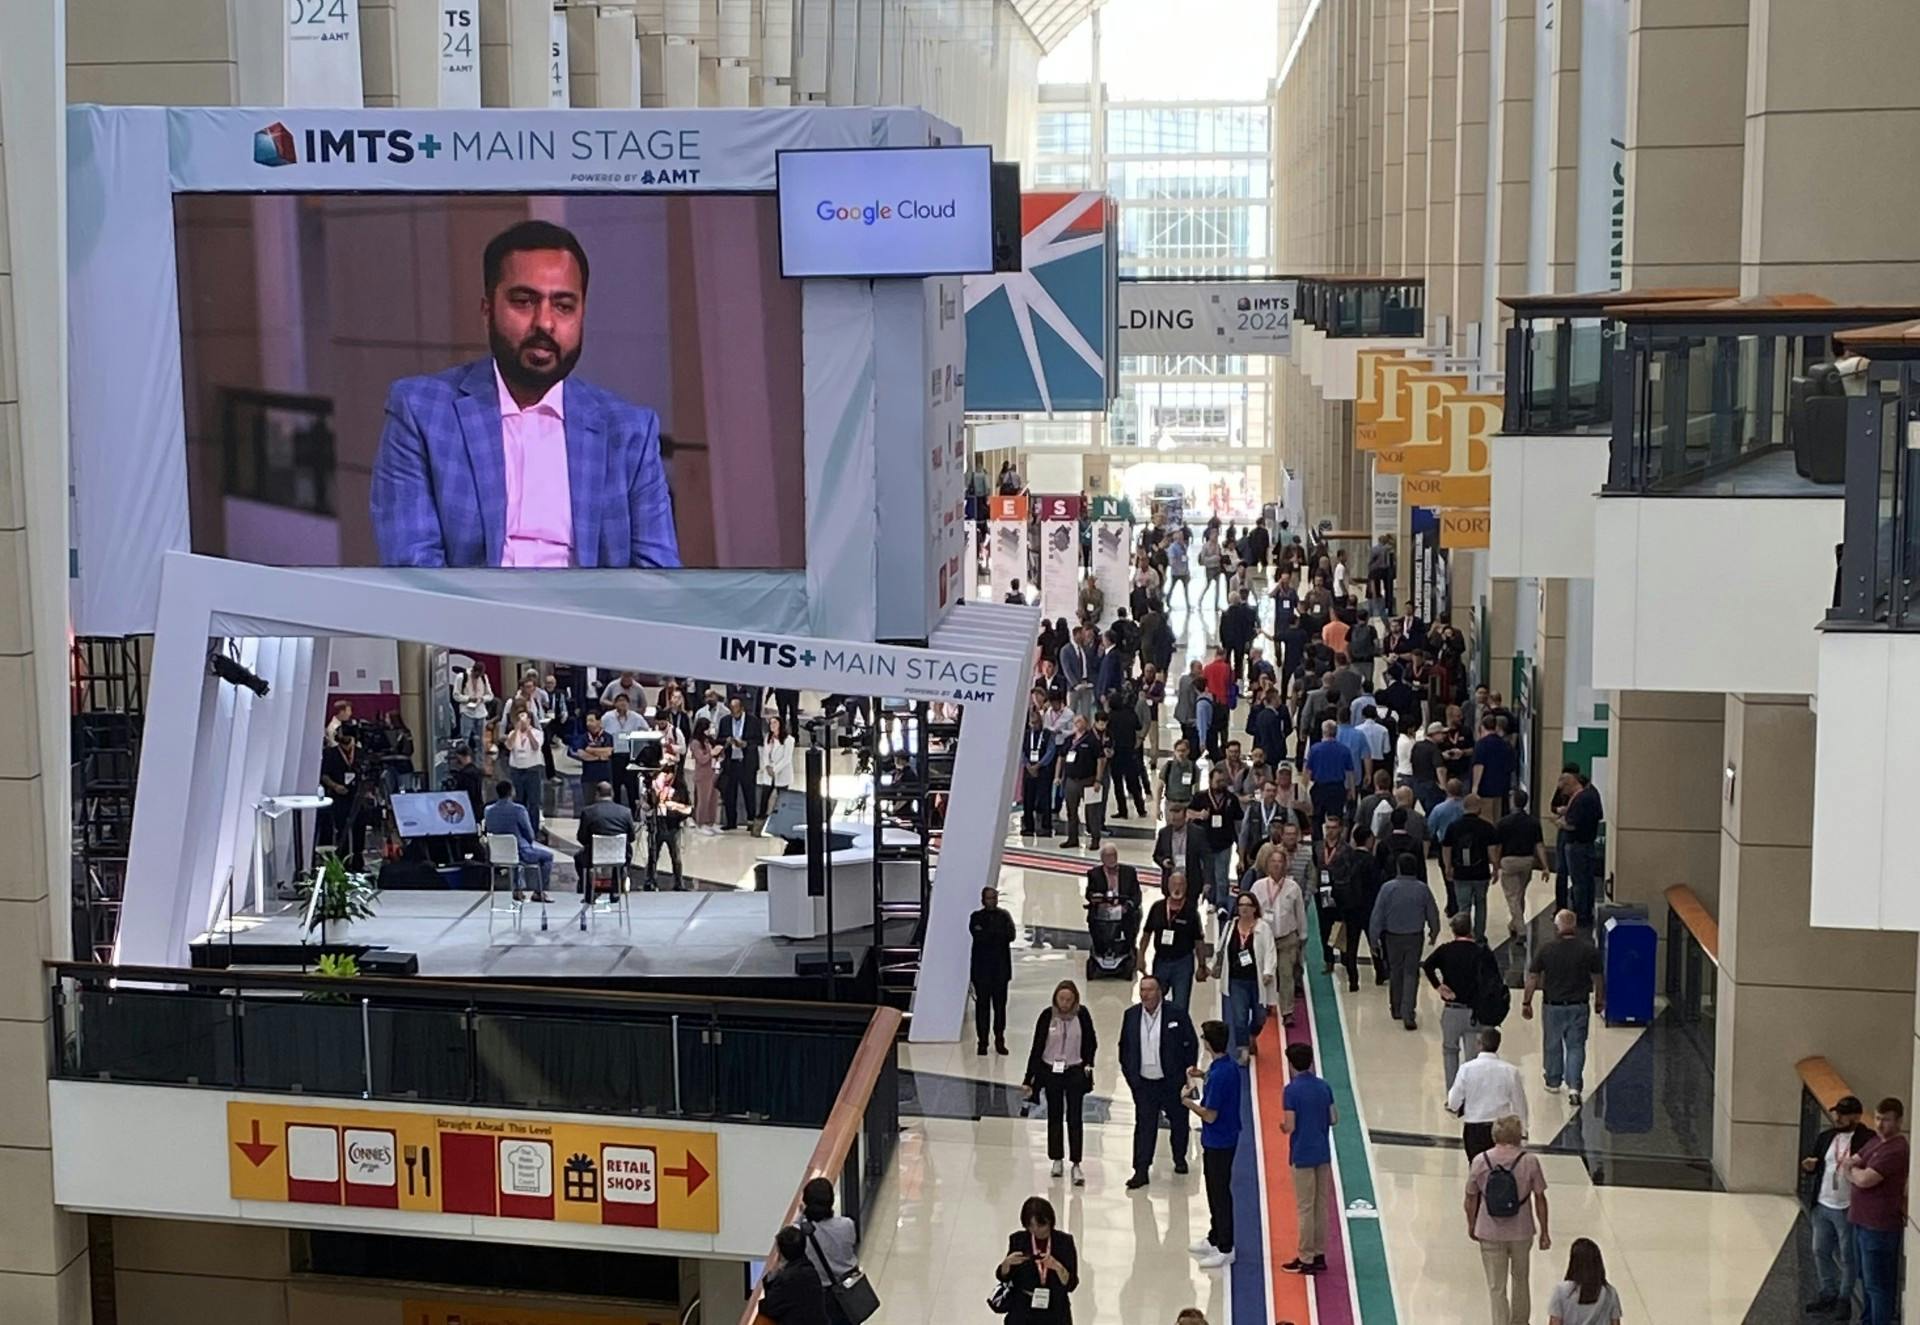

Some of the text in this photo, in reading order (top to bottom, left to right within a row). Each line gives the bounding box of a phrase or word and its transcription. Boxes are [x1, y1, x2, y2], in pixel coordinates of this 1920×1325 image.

[444, 9, 471, 28] TS
[305, 129, 701, 165] IMTS+ MAIN STAGE
[570, 168, 701, 185] POWERED BY AMT
[816, 198, 956, 226] Google Cloud
[1254, 297, 1290, 311] IMTS
[1237, 312, 1289, 331] 2024
[1003, 501, 1015, 515] E
[1054, 500, 1067, 515] S
[1104, 501, 1117, 515] N
[719, 636, 999, 686] IMTS+ MAIN STAGE
[963, 690, 994, 703] AMT
[437, 1118, 552, 1135] Straight Ahead This Level
[606, 1158, 651, 1176] RETAIL
[606, 1176, 651, 1193] SHOPS
